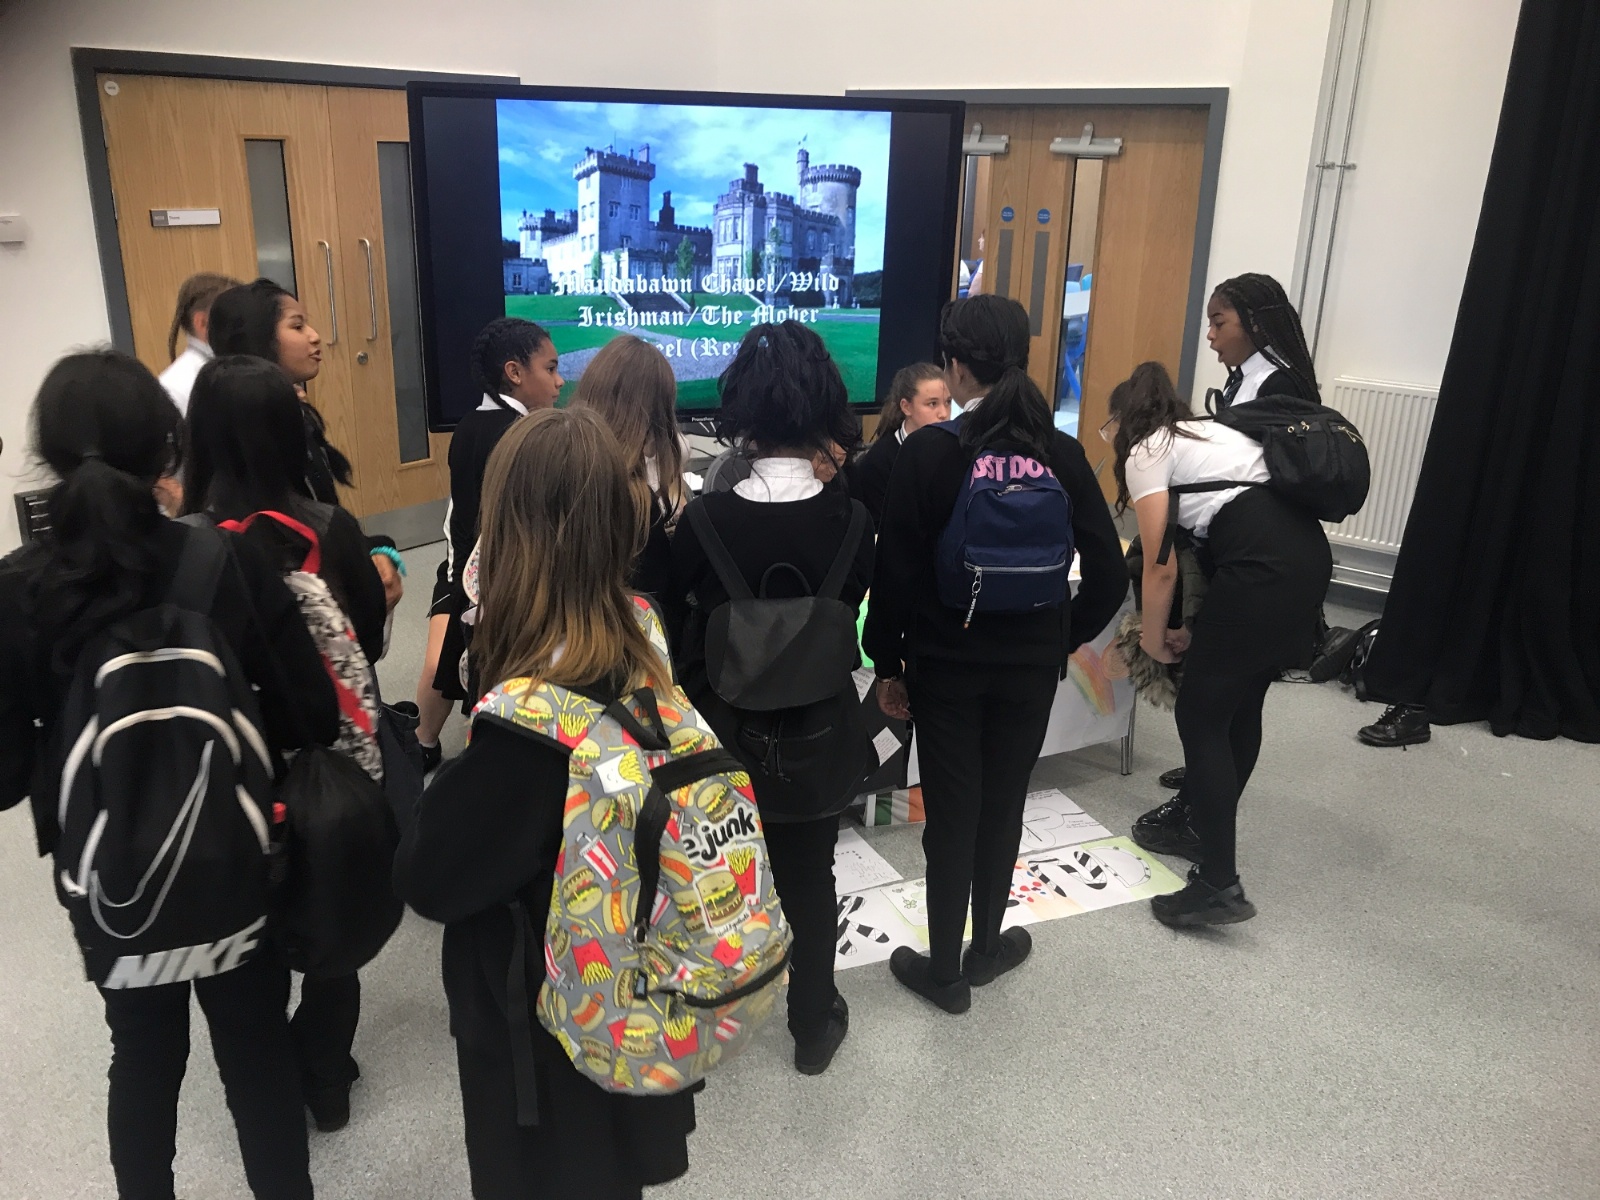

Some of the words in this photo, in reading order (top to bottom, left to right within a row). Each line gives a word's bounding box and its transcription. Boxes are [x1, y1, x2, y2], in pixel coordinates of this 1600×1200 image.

[750, 304, 819, 327] Moher
[1009, 455, 1045, 479] DO
[700, 806, 756, 861] junk
[101, 914, 268, 990] NIKE
